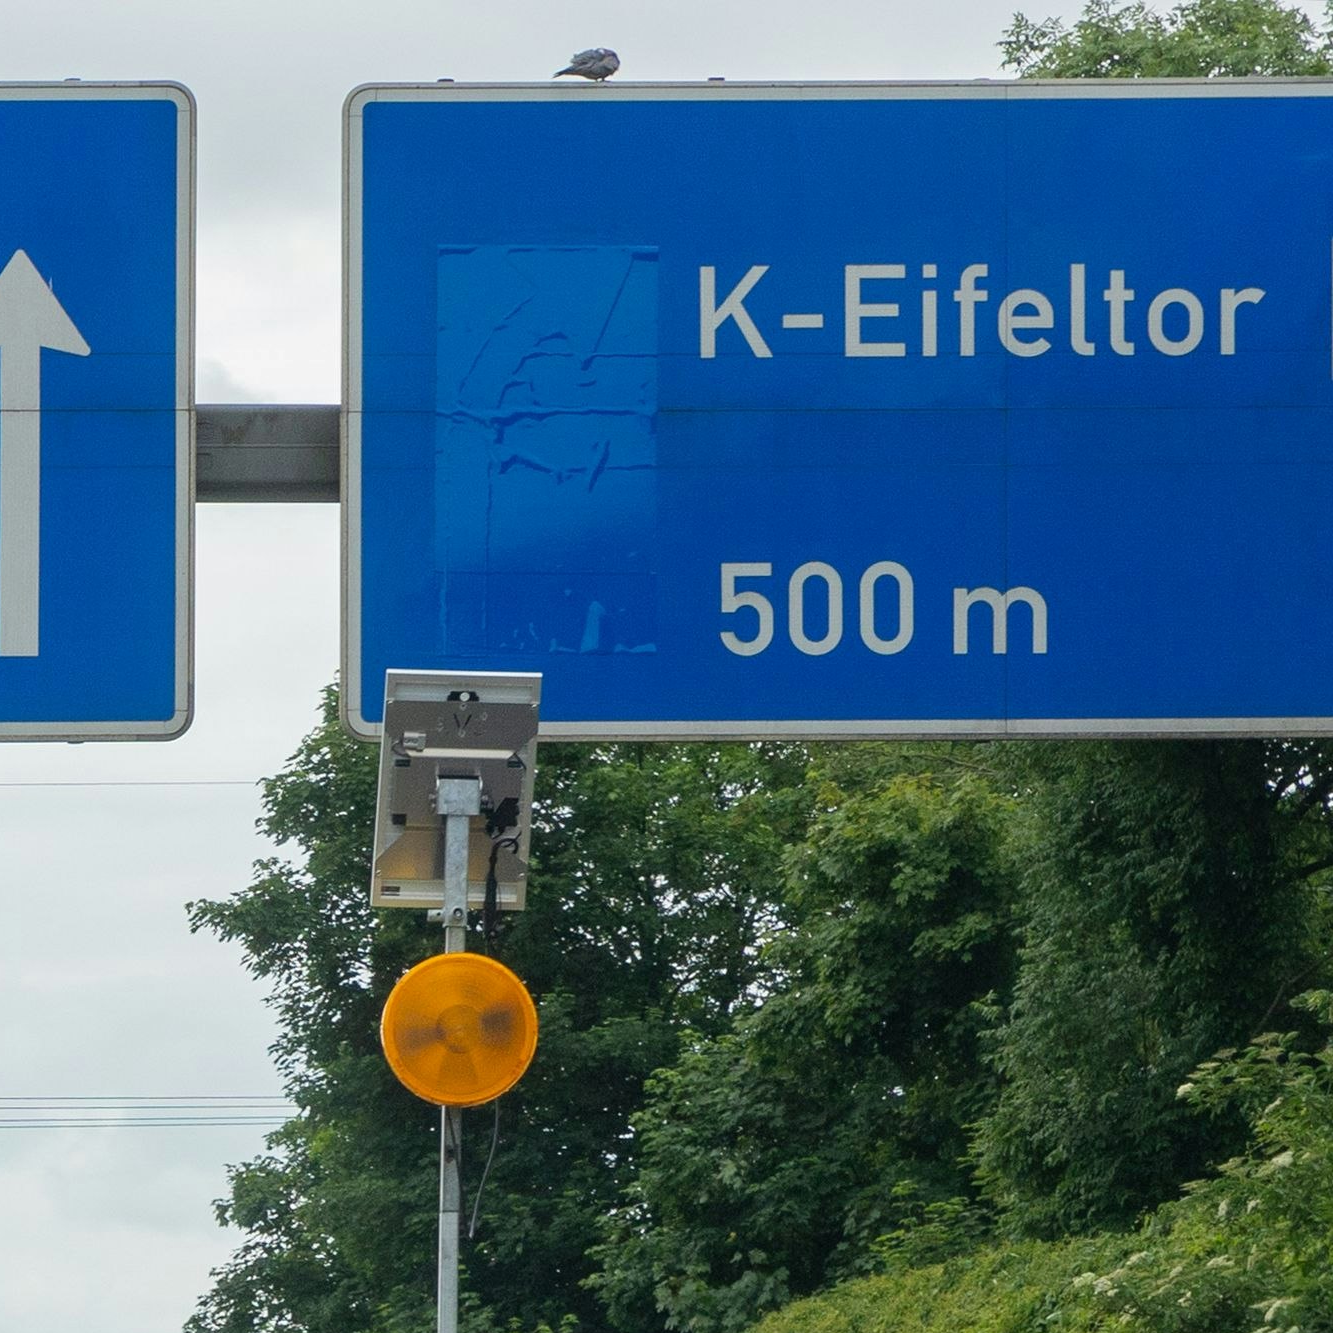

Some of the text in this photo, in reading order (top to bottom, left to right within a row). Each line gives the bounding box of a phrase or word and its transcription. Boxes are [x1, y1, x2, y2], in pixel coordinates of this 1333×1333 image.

[699, 263, 1266, 359] K-Eifeltor
[720, 561, 1047, 656] 500 m
